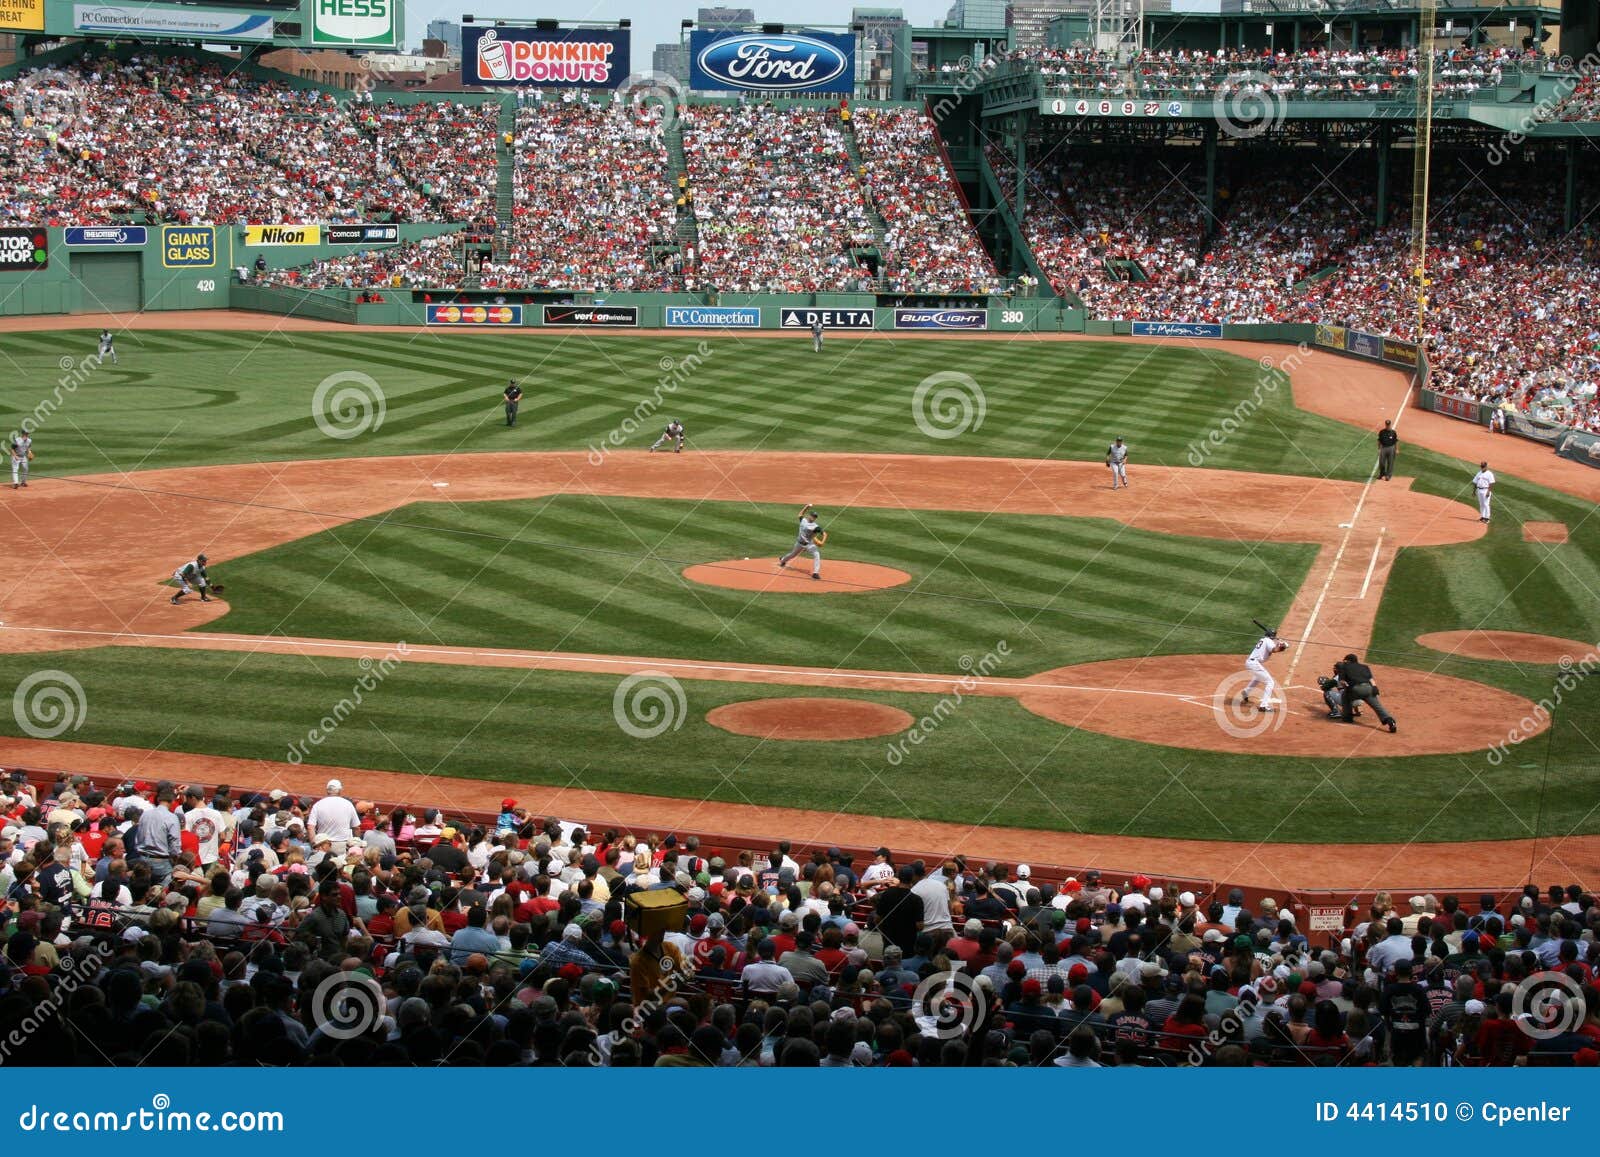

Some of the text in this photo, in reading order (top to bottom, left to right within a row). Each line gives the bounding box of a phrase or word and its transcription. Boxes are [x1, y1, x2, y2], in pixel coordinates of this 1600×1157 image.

[0, 0, 35, 9] ETHING
[321, 0, 386, 17] HESS
[95, 12, 140, 25] Connection
[515, 43, 612, 61] DUNKIN'
[728, 42, 817, 79] Ford
[515, 62, 609, 80] DONUTS
[1078, 102, 1085, 112] 4
[1101, 102, 1109, 113] 8
[1124, 103, 1132, 113] 9
[1144, 103, 1160, 114] 27
[1169, 104, 1181, 114] 42
[168, 232, 209, 246] GIANT
[260, 228, 305, 244] Nikon
[168, 247, 210, 260] GLASS
[196, 280, 215, 292] 420
[575, 312, 609, 322] verizon
[672, 310, 754, 324] PC Connection
[807, 312, 872, 325] DELTA
[901, 314, 979, 322] BUD LIGHT
[1001, 311, 1023, 323] 380
